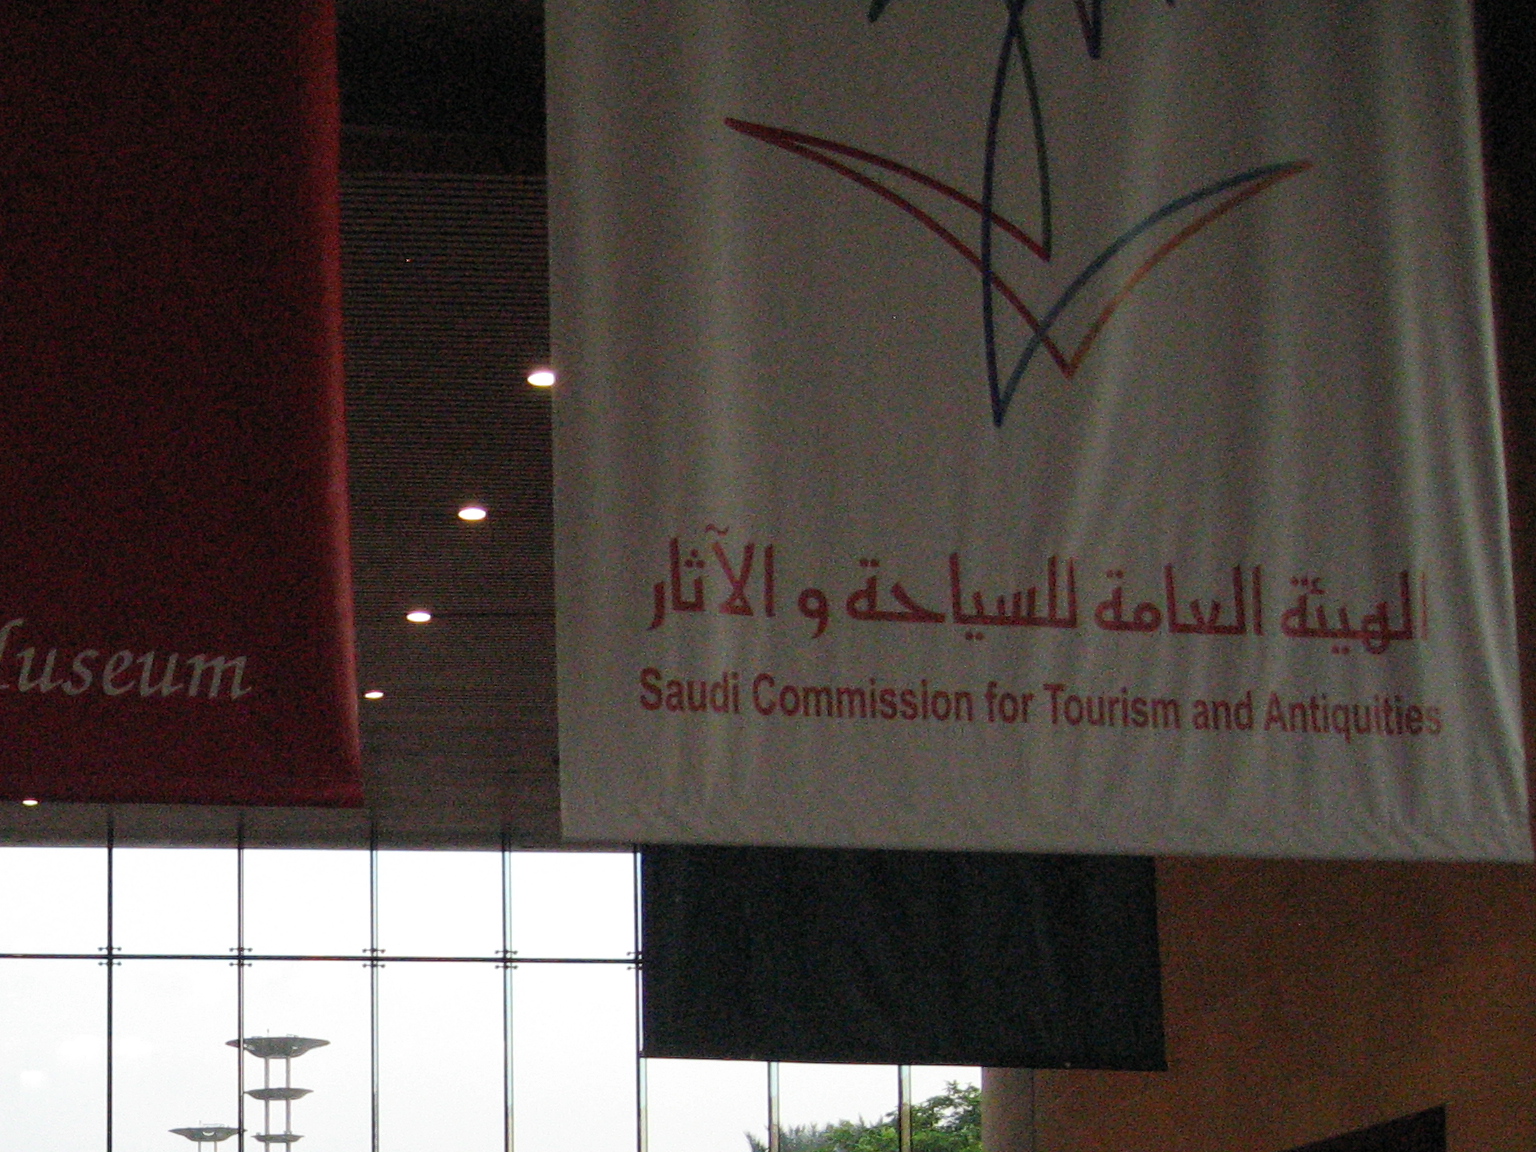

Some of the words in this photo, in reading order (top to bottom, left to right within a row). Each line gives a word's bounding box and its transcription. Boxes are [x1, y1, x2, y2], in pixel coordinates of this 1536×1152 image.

[797, 587, 830, 639] و
[845, 551, 1078, 640] للسياحة
[1094, 563, 1263, 635] العامة
[1281, 570, 1428, 655] الهيئة
[639, 666, 741, 714] Saudi
[752, 672, 974, 722] Commission
[984, 680, 1034, 724] for
[1043, 683, 1181, 729] Tourism
[1192, 690, 1254, 731] and
[1264, 692, 1443, 744] Antiquities
